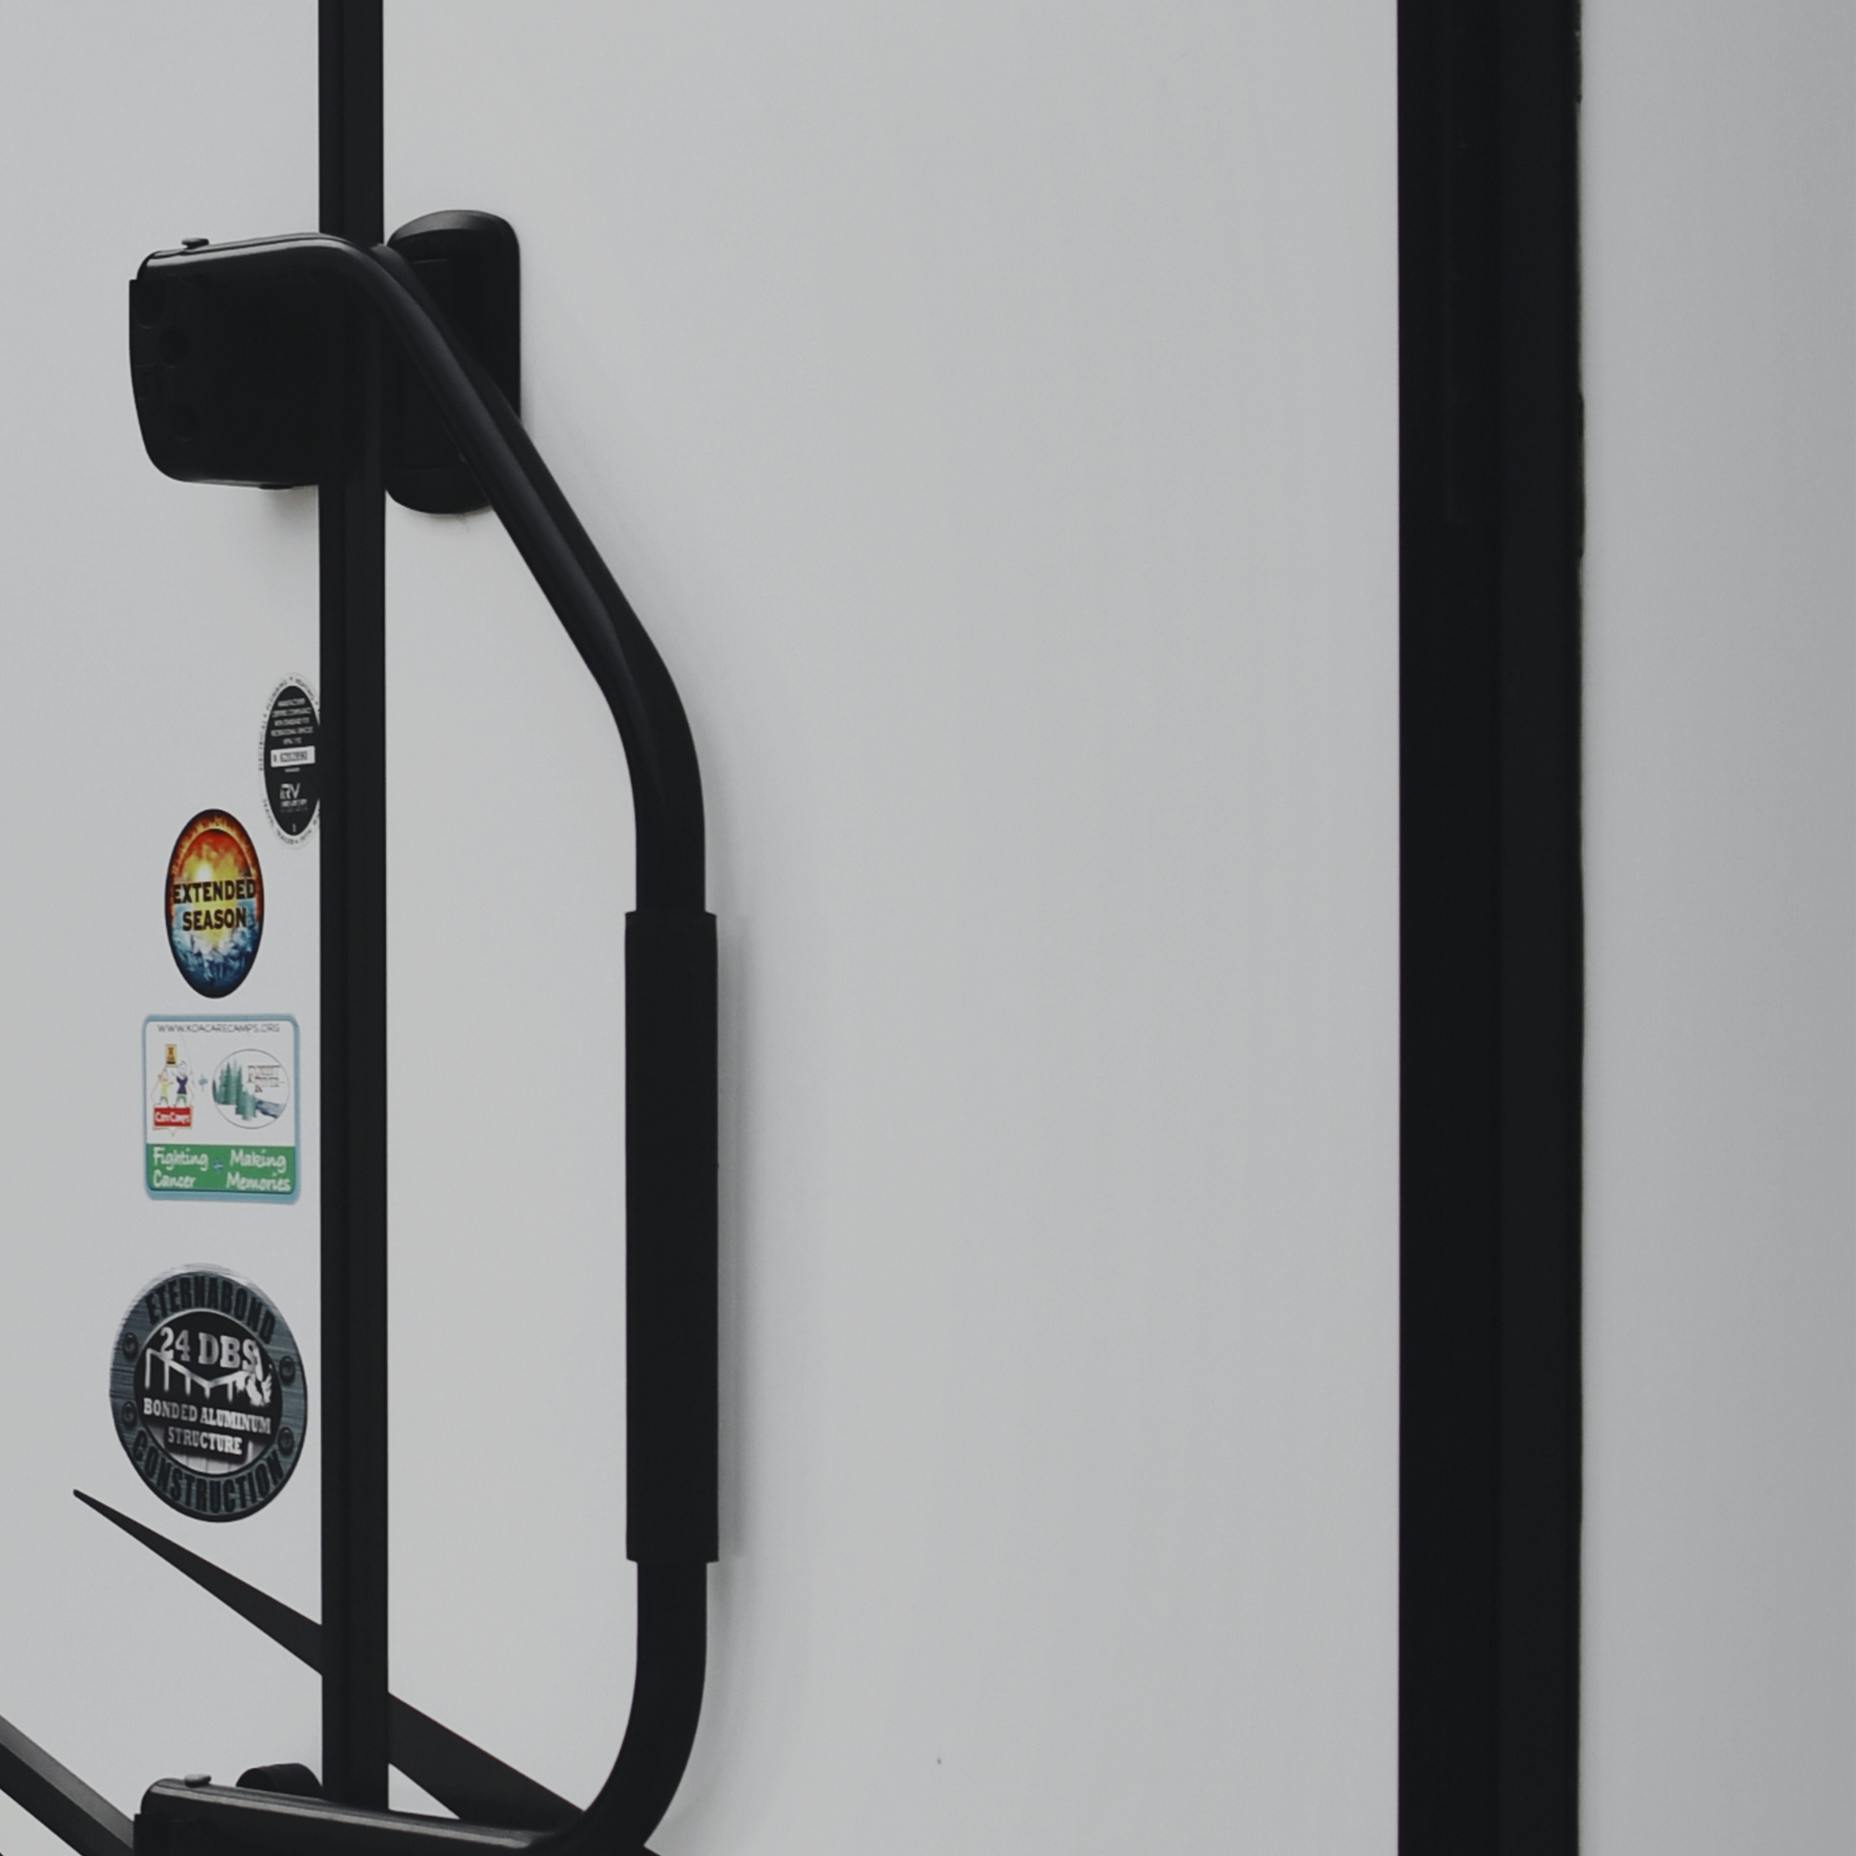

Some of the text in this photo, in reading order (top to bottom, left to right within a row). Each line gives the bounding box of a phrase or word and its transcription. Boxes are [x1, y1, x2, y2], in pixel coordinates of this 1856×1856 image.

[172, 878, 257, 904] EXTENDED
[182, 907, 248, 932] SEASON
[152, 1146, 209, 1171] Fighting
[229, 1148, 287, 1174] Making
[152, 1169, 197, 1189] Cancer
[226, 1171, 291, 1192] Memories
[145, 1274, 277, 1345] ETERNABOND
[159, 1326, 259, 1371] 24 DBS
[143, 1397, 272, 1435] BONDED ALUMINUM
[167, 1425, 244, 1456] STRUCTURE
[133, 1428, 286, 1514] CONSTRUCTION
